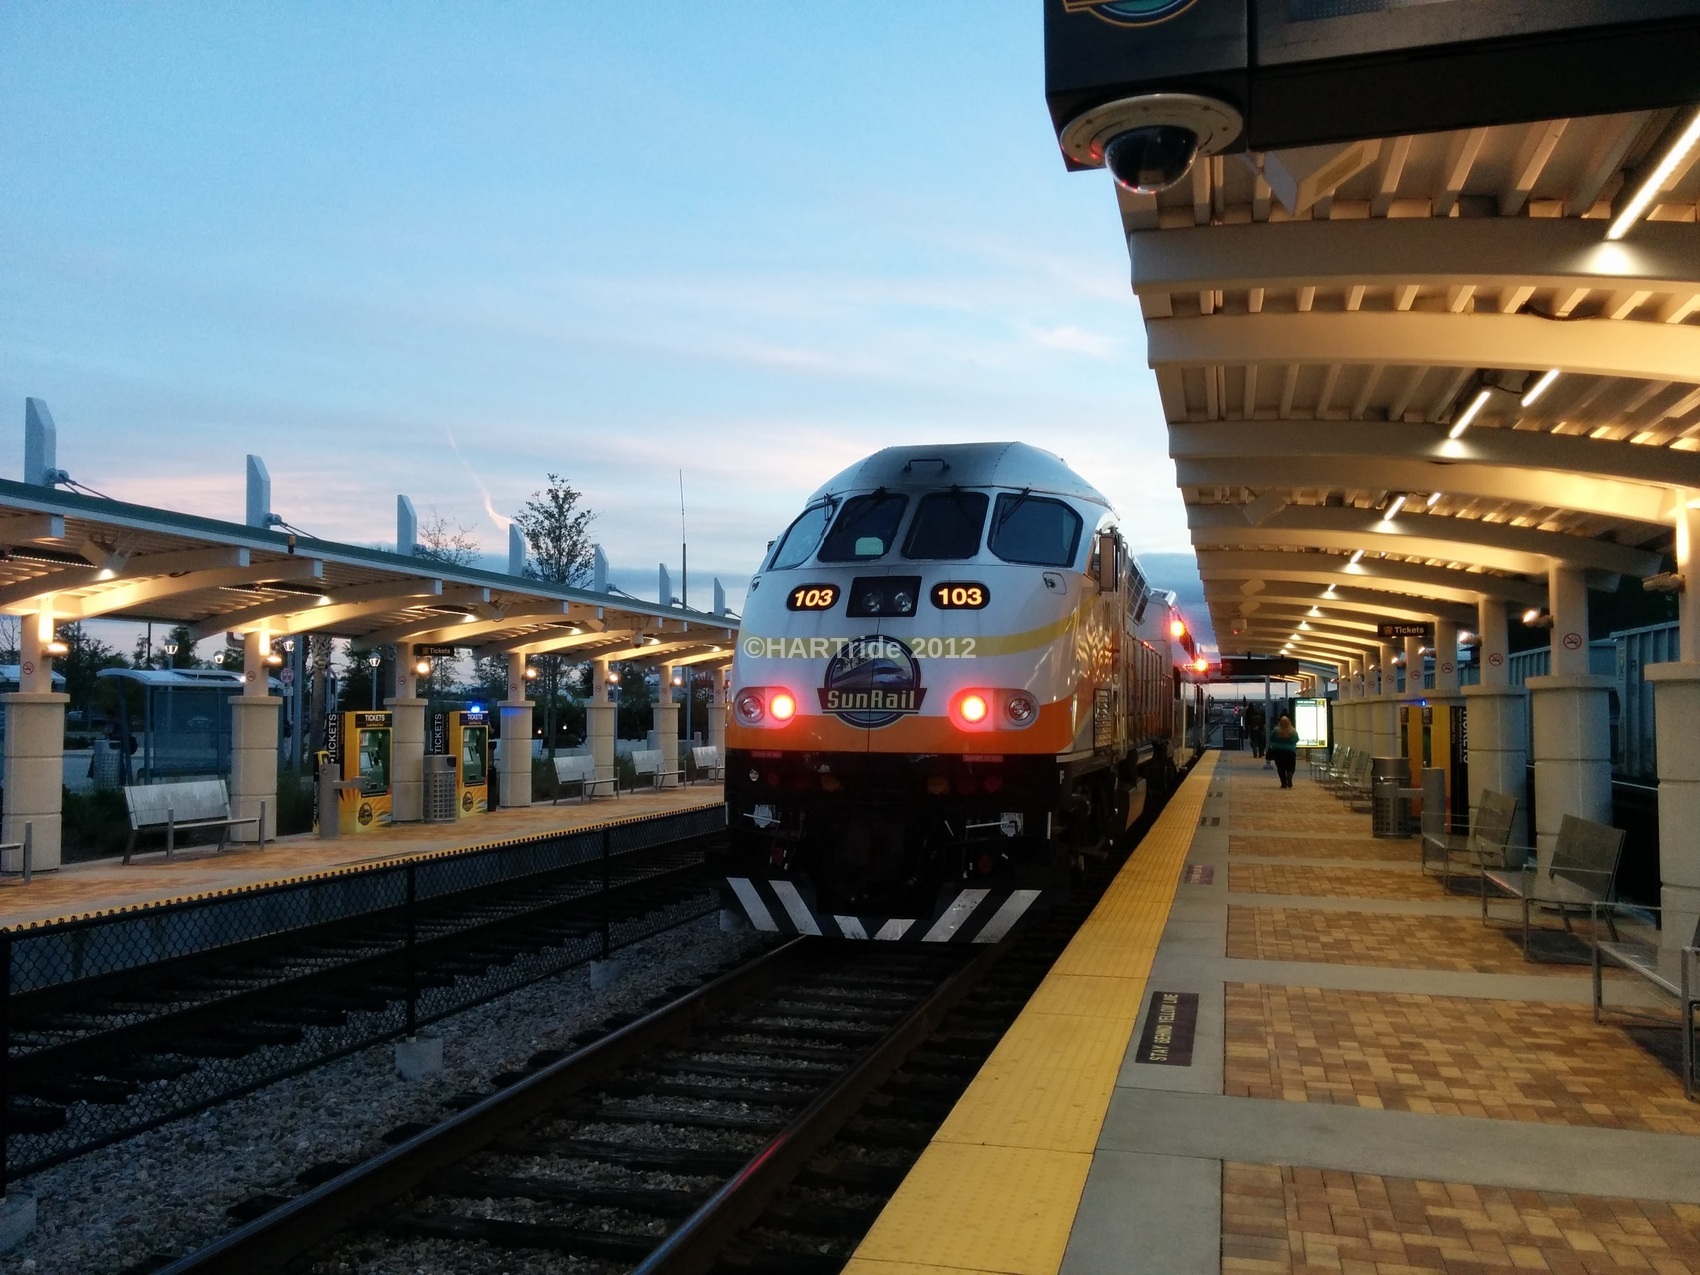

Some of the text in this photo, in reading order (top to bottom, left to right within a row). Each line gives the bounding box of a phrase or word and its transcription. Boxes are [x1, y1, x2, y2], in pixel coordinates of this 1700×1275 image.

[795, 590, 833, 607] 103
[938, 588, 982, 605] 103
[1394, 626, 1424, 634] Tickets
[827, 689, 915, 709] SunRail
[365, 714, 385, 722] TICKETS
[328, 713, 337, 759] TICKETS
[434, 713, 442, 754] TICKETS
[1149, 994, 1178, 1061] STAY BEHIND YELLOW LINE
